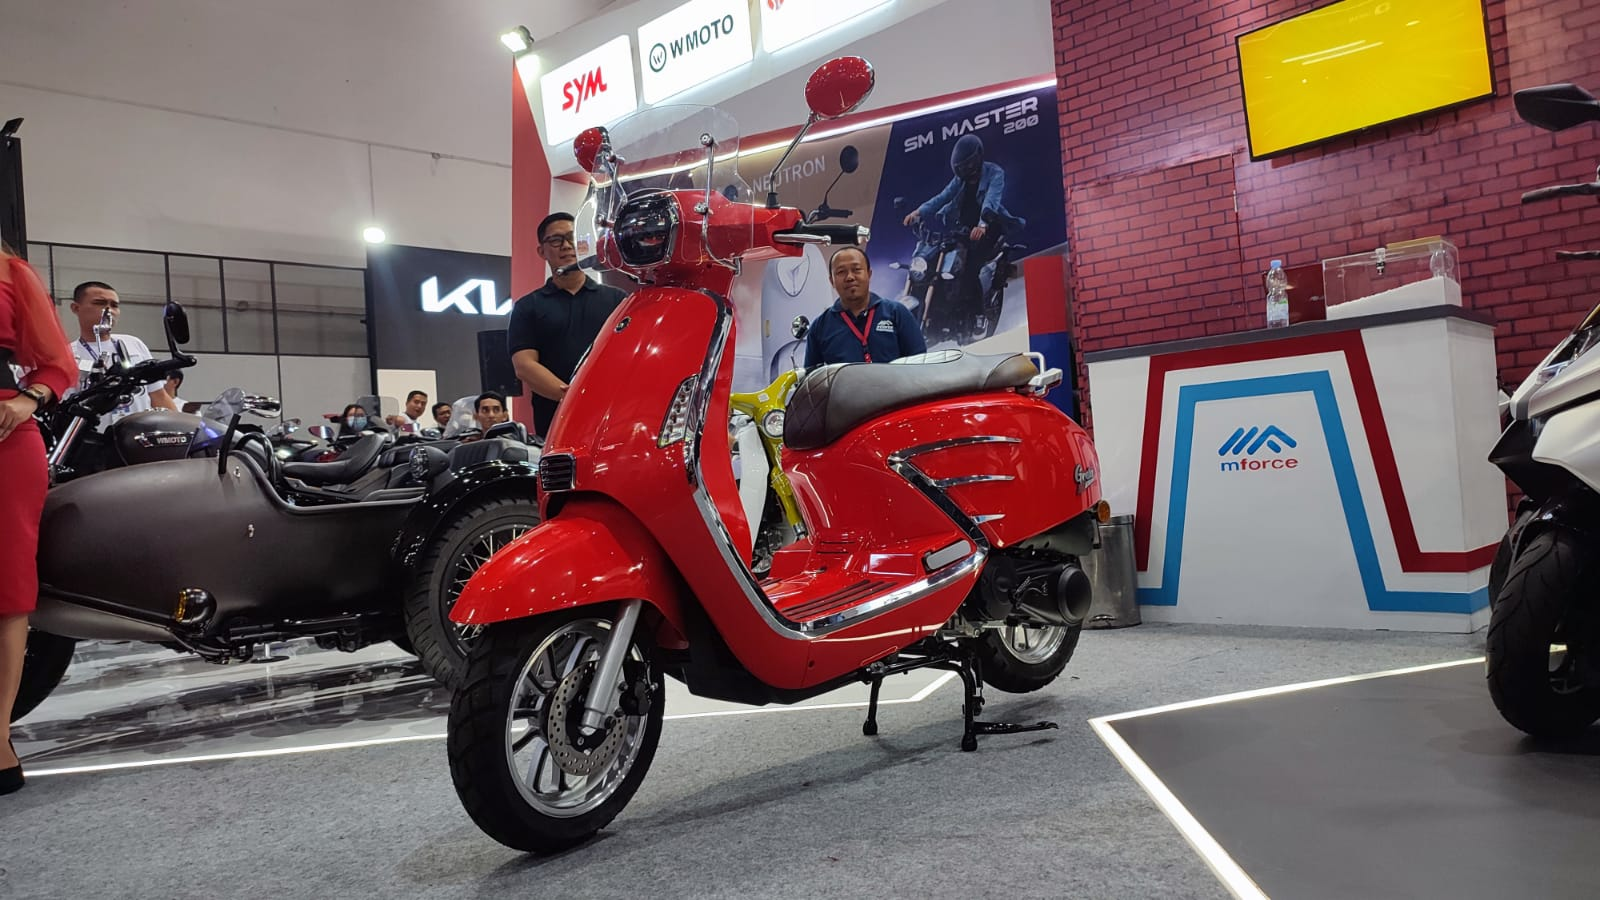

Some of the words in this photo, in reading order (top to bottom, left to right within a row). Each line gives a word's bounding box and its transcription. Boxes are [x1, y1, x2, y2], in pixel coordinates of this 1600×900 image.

[670, 14, 734, 59] WMOTO
[562, 66, 608, 113] SYM
[903, 131, 934, 153] SM
[942, 97, 1039, 141] MASTER
[1003, 114, 1039, 135] 200
[1220, 458, 1298, 471] mforce
